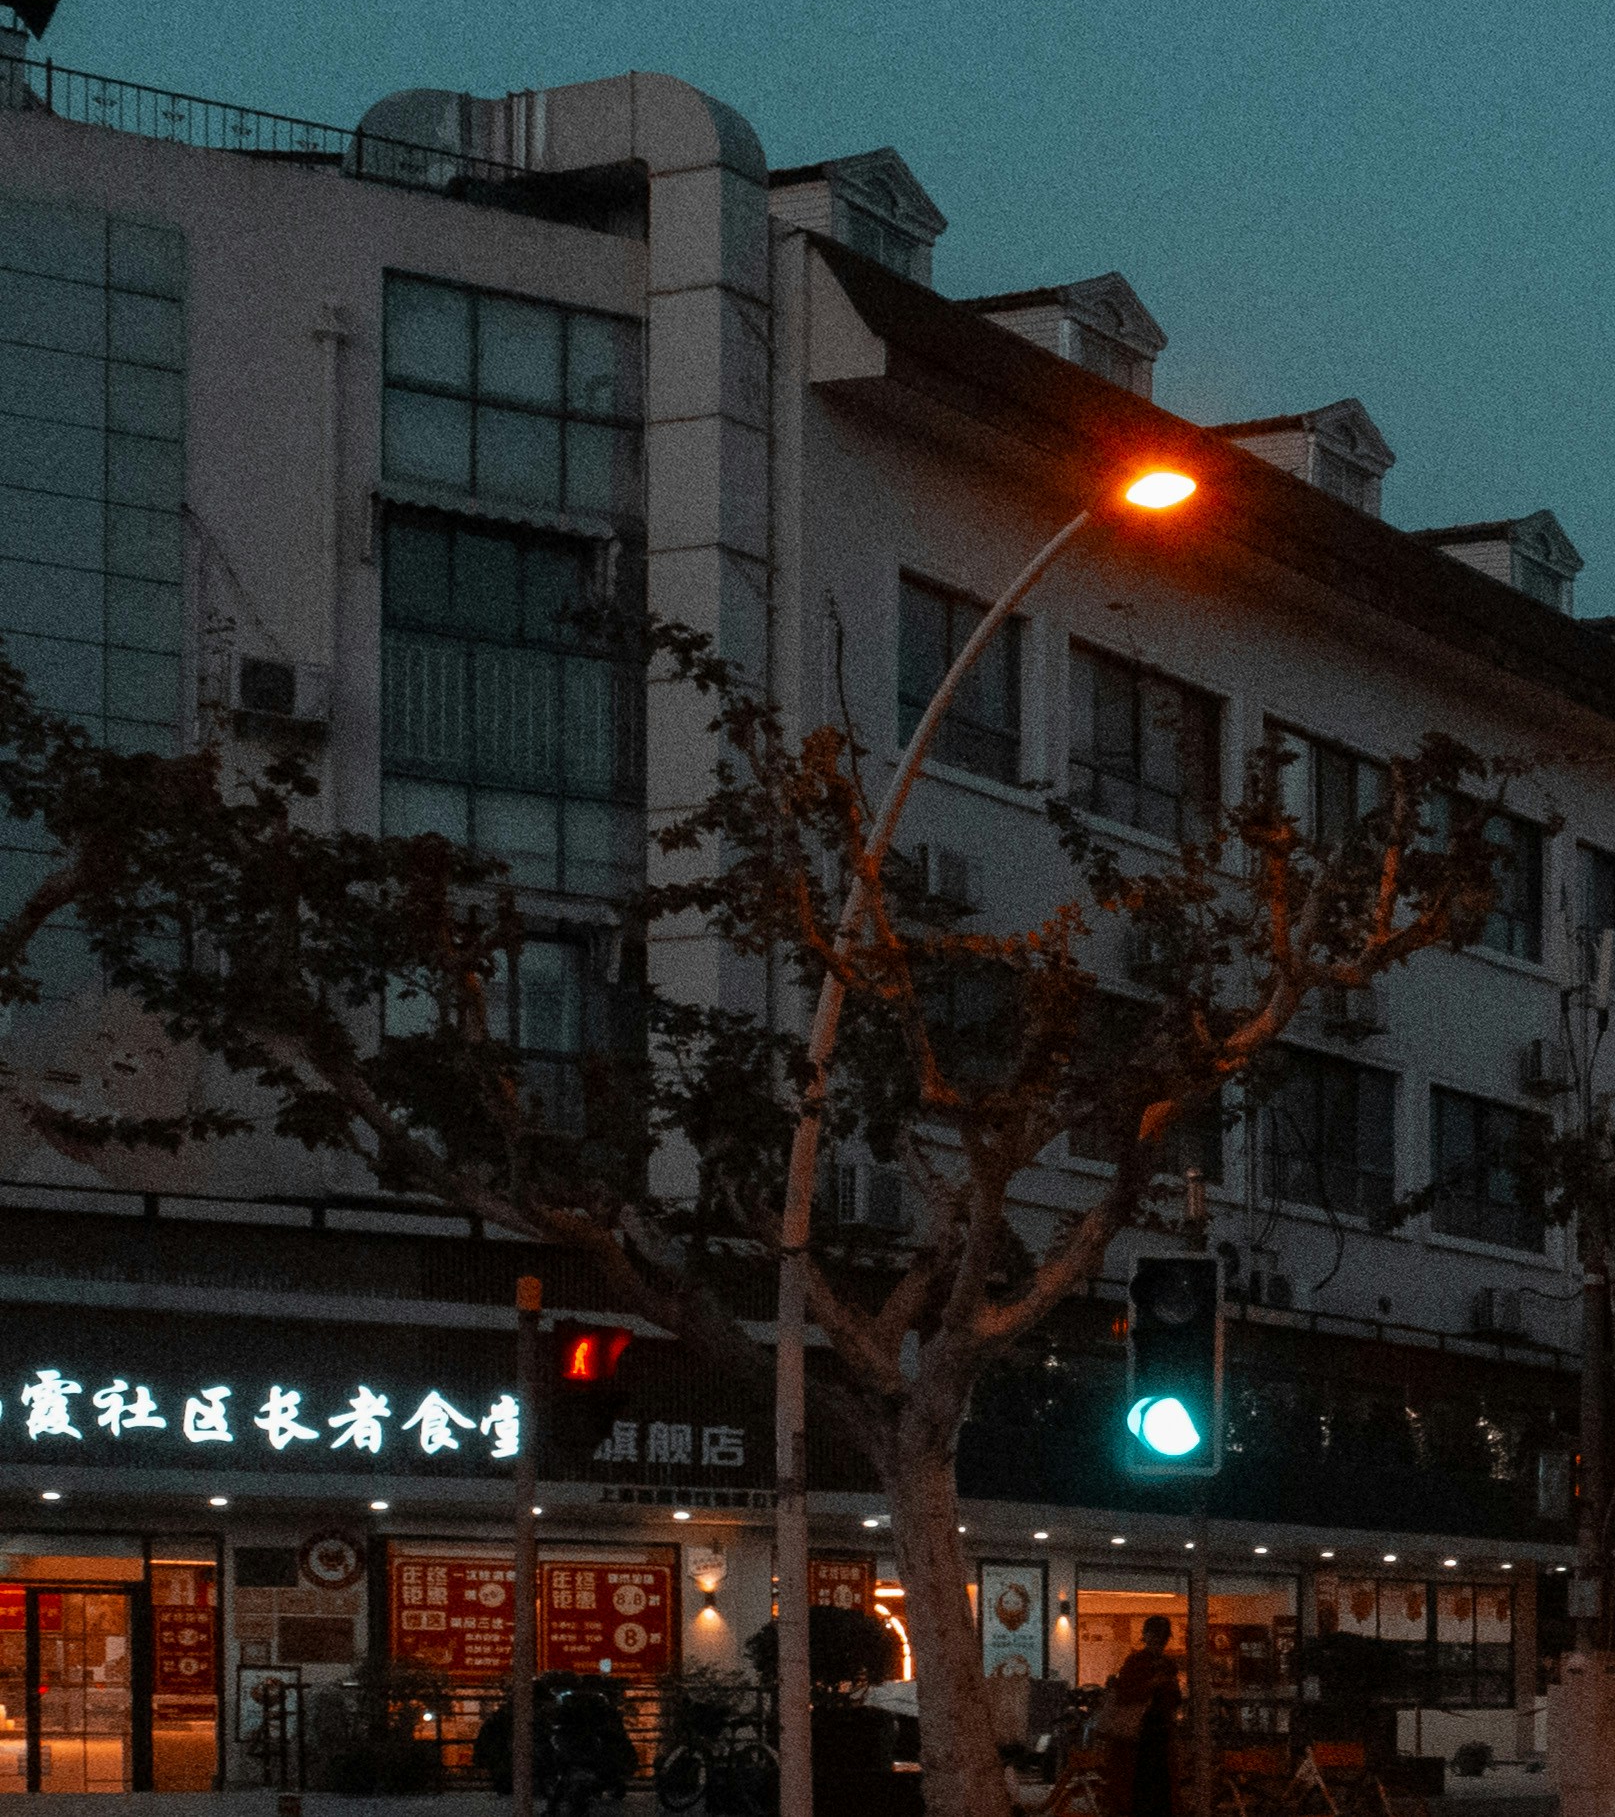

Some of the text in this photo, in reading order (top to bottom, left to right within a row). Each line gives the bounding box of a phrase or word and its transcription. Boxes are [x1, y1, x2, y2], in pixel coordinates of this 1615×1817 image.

[0, 1368, 521, 1459] 霞社区长者食堂
[624, 1628, 638, 1647] 8
